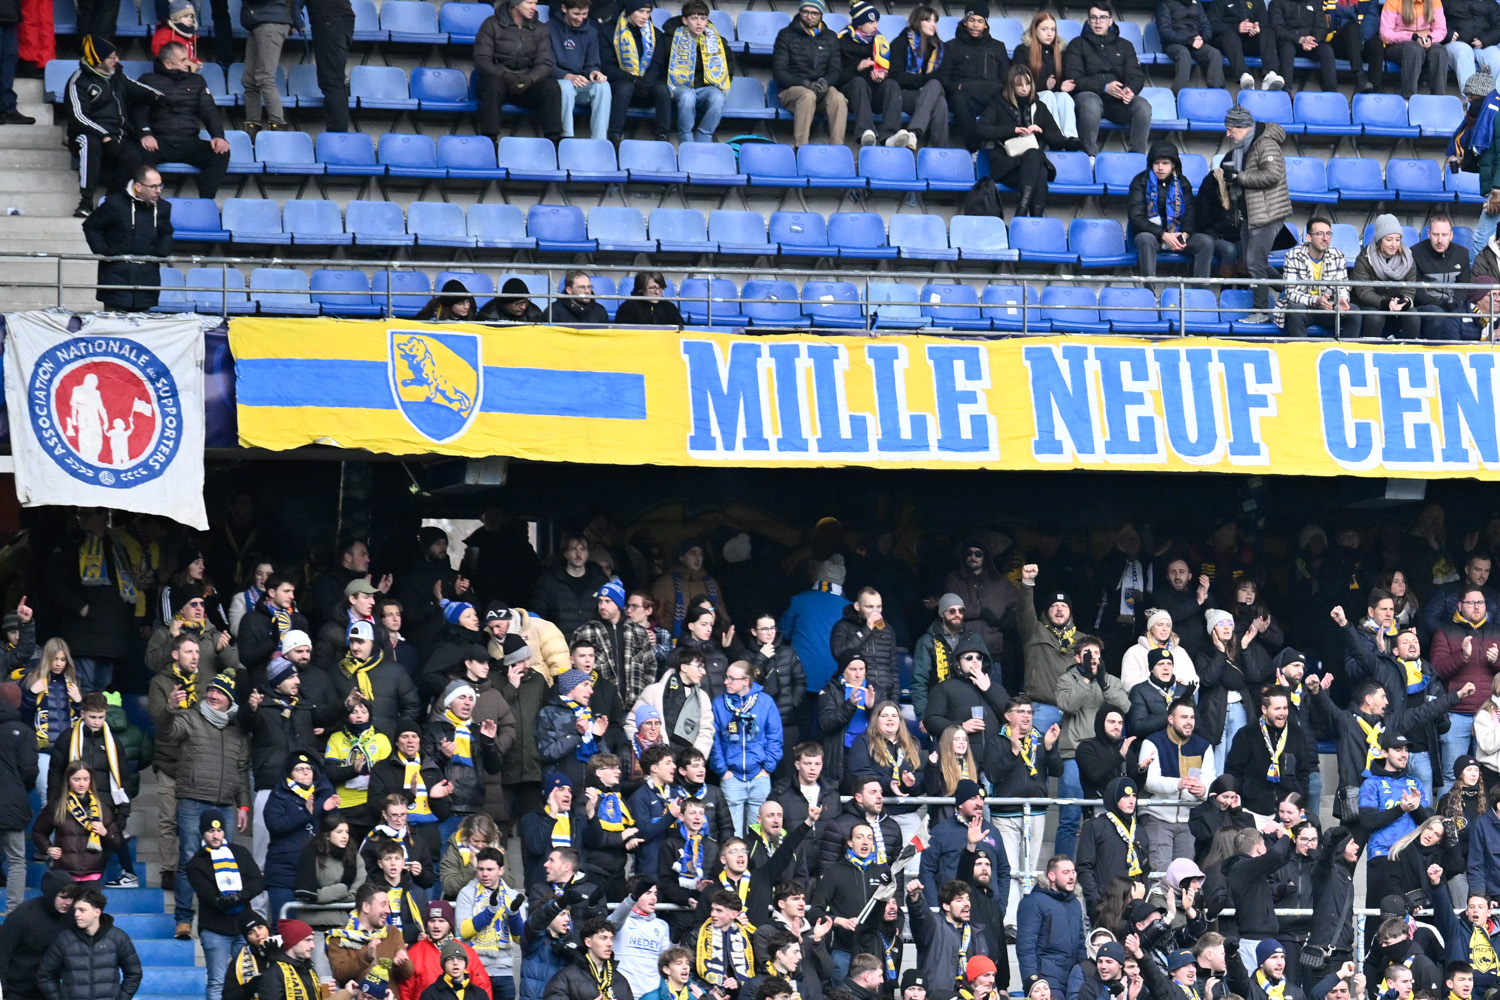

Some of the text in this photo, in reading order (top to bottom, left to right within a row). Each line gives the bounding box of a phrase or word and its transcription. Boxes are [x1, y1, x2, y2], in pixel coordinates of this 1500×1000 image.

[34, 358, 67, 456] ASSOCIATION
[56, 340, 149, 367] NATIONALE
[149, 377, 177, 470] SUPPORTERS
[680, 338, 999, 460] MILLE
[1023, 344, 1282, 465] NEUF
[629, 937, 660, 950] NEDEY
